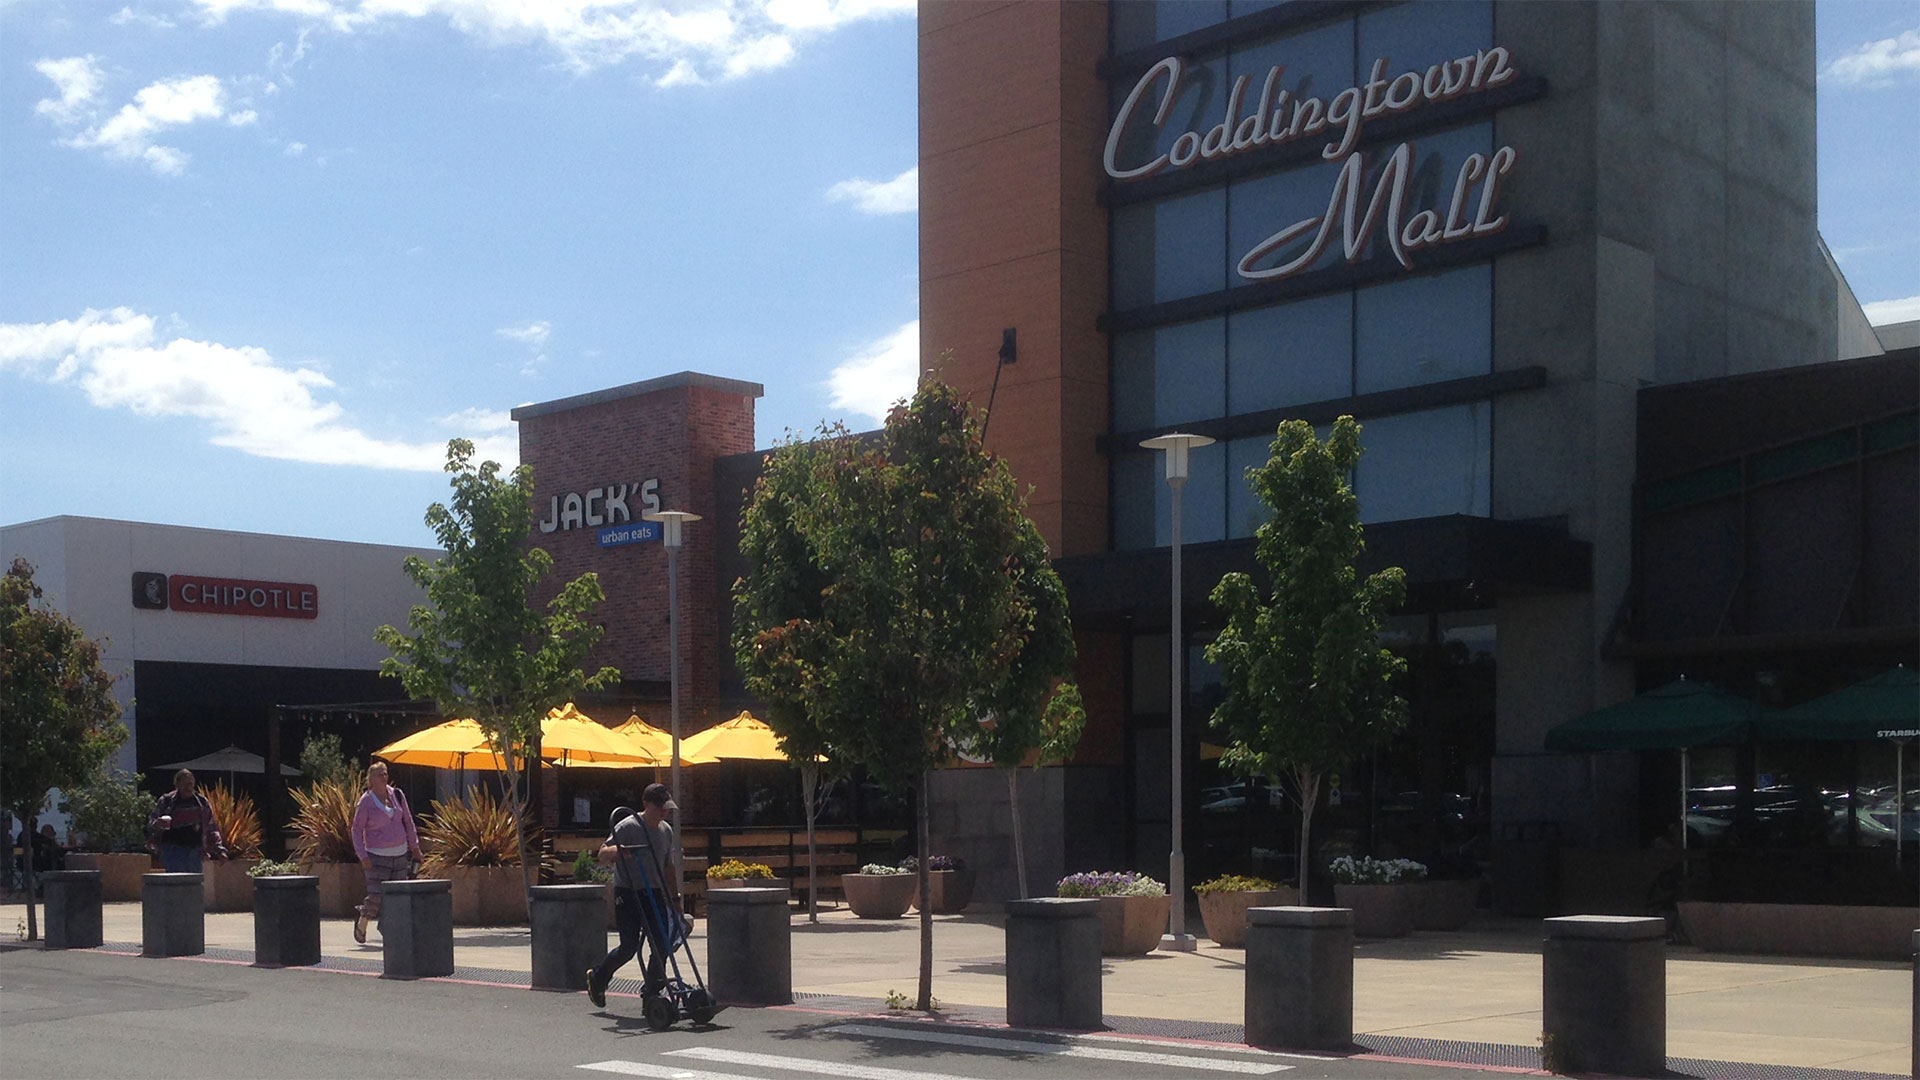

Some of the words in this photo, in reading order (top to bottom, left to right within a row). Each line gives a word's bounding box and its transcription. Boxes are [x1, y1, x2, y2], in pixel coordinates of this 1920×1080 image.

[1102, 45, 1515, 180] Coddingtown
[1237, 141, 1518, 280] Mall
[539, 478, 660, 534] JACK'S
[601, 530, 629, 544] urban
[631, 526, 652, 540] eats
[181, 583, 314, 611] CHIPOTLE
[1876, 729, 1920, 738] STARBU
